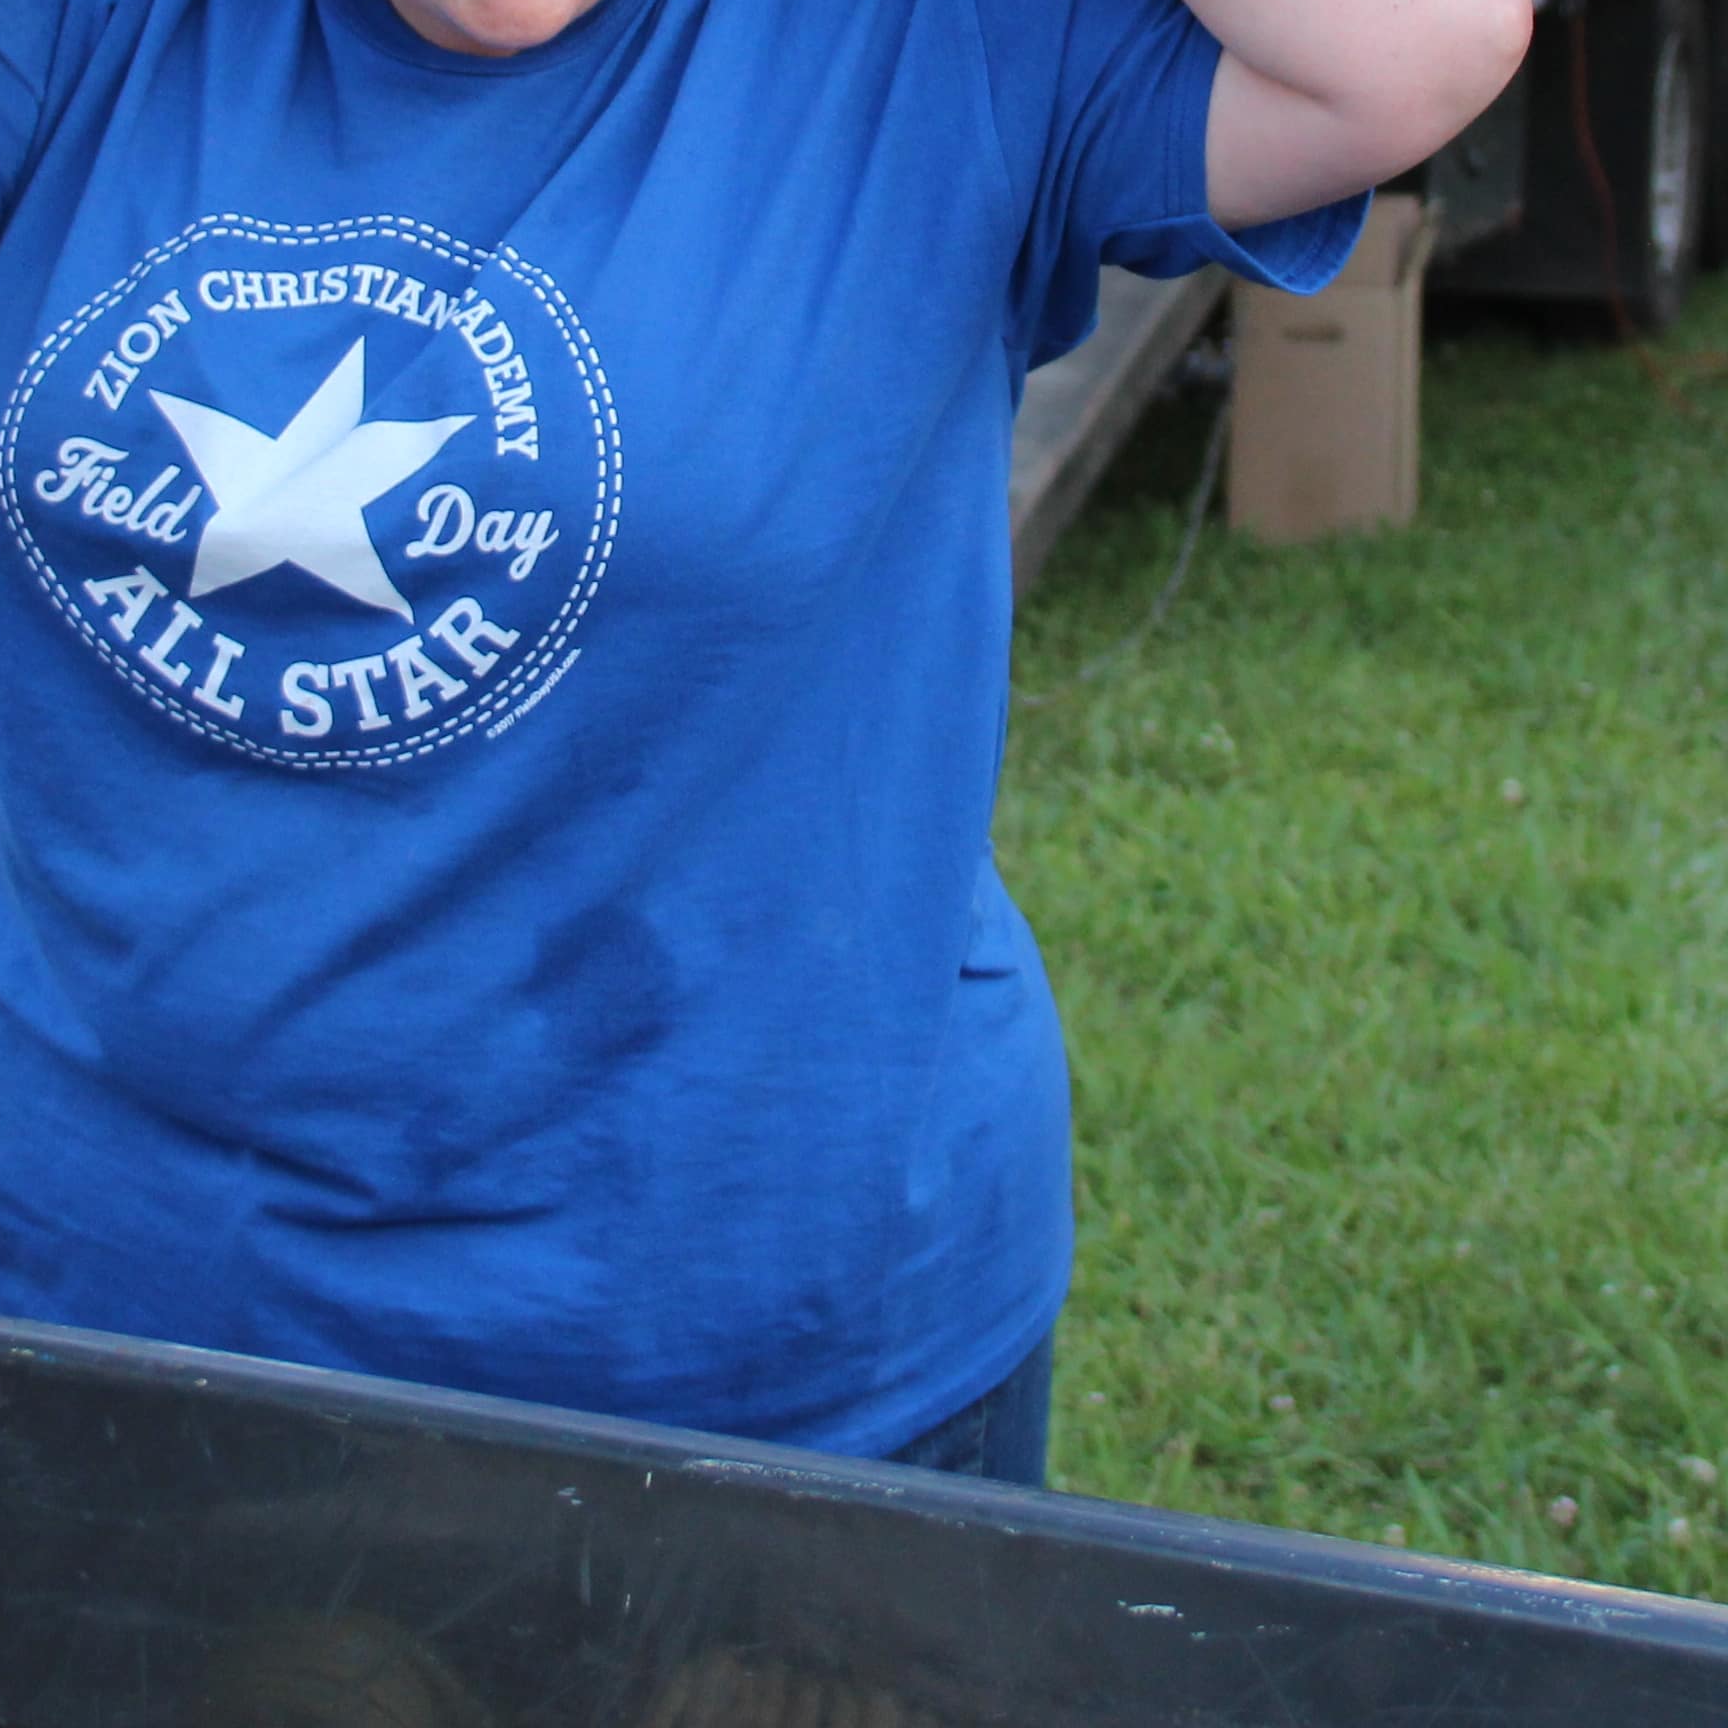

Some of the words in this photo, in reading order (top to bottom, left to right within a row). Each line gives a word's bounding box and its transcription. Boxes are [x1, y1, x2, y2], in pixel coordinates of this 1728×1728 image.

[84, 289, 191, 410] ZION
[199, 264, 459, 331] CHRISTIAN
[452, 287, 539, 460] ADEMY
[35, 437, 202, 542] Field
[405, 484, 559, 581] Day
[83, 565, 246, 721] ALL
[281, 596, 521, 736] STAR
